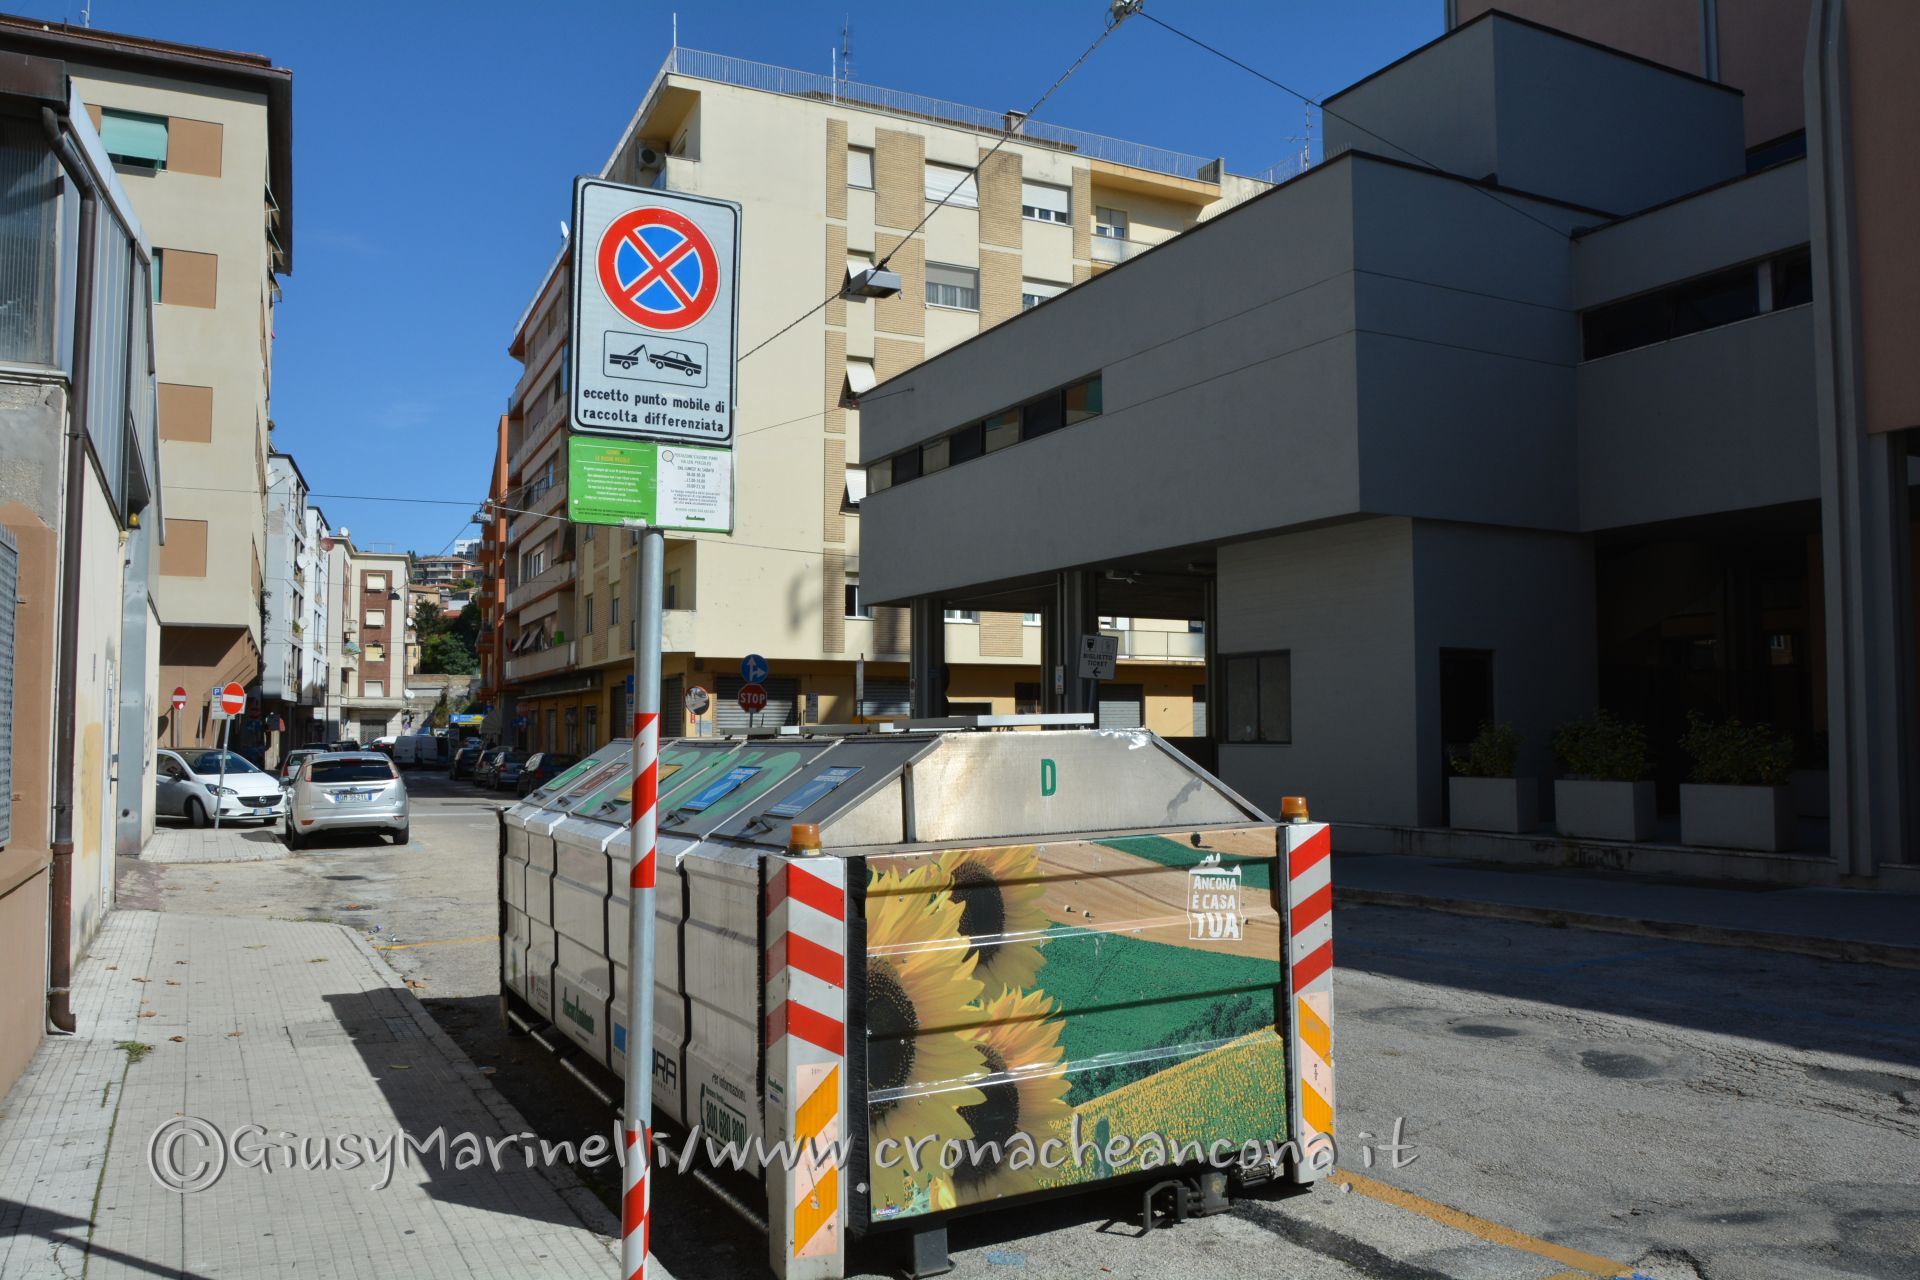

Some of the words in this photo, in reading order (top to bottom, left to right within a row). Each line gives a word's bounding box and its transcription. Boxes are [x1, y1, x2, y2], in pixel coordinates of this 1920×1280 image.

[583, 389, 629, 402] eccetto
[634, 394, 668, 406] punto
[673, 398, 710, 411] mobile
[715, 401, 725, 413] di
[583, 409, 638, 423] raccolta
[644, 412, 724, 433] differenziata
[1083, 653, 1113, 661] BIGLIETTO
[740, 692, 766, 704] STOP
[1041, 758, 1056, 796] D
[1193, 875, 1237, 891] ANCONA
[1202, 894, 1236, 910] CASA
[1192, 912, 1240, 939] TUA
